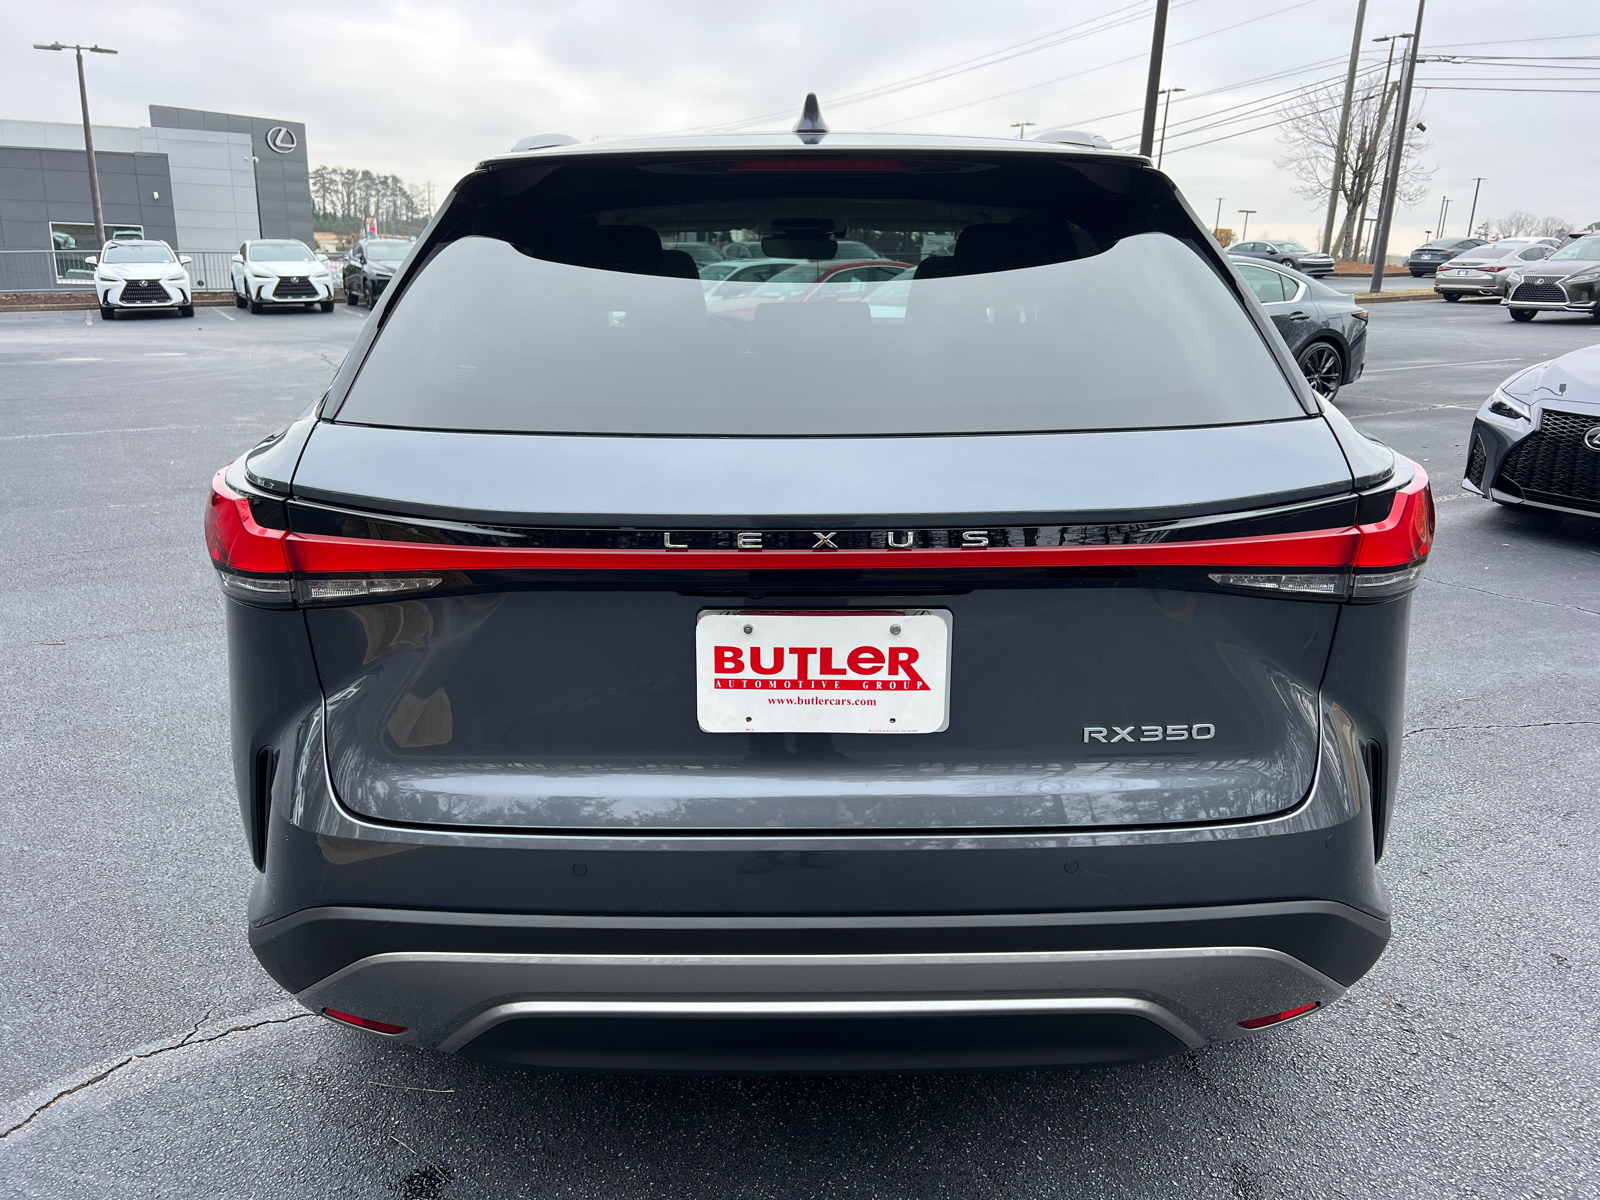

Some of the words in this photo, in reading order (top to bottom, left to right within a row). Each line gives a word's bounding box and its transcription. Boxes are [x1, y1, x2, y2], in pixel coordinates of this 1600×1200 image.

[663, 530, 989, 549] LEXUS
[715, 679, 841, 690] AUTOMOTIVE
[862, 681, 924, 690] GROUP
[767, 696, 877, 706] www.butlercars.com
